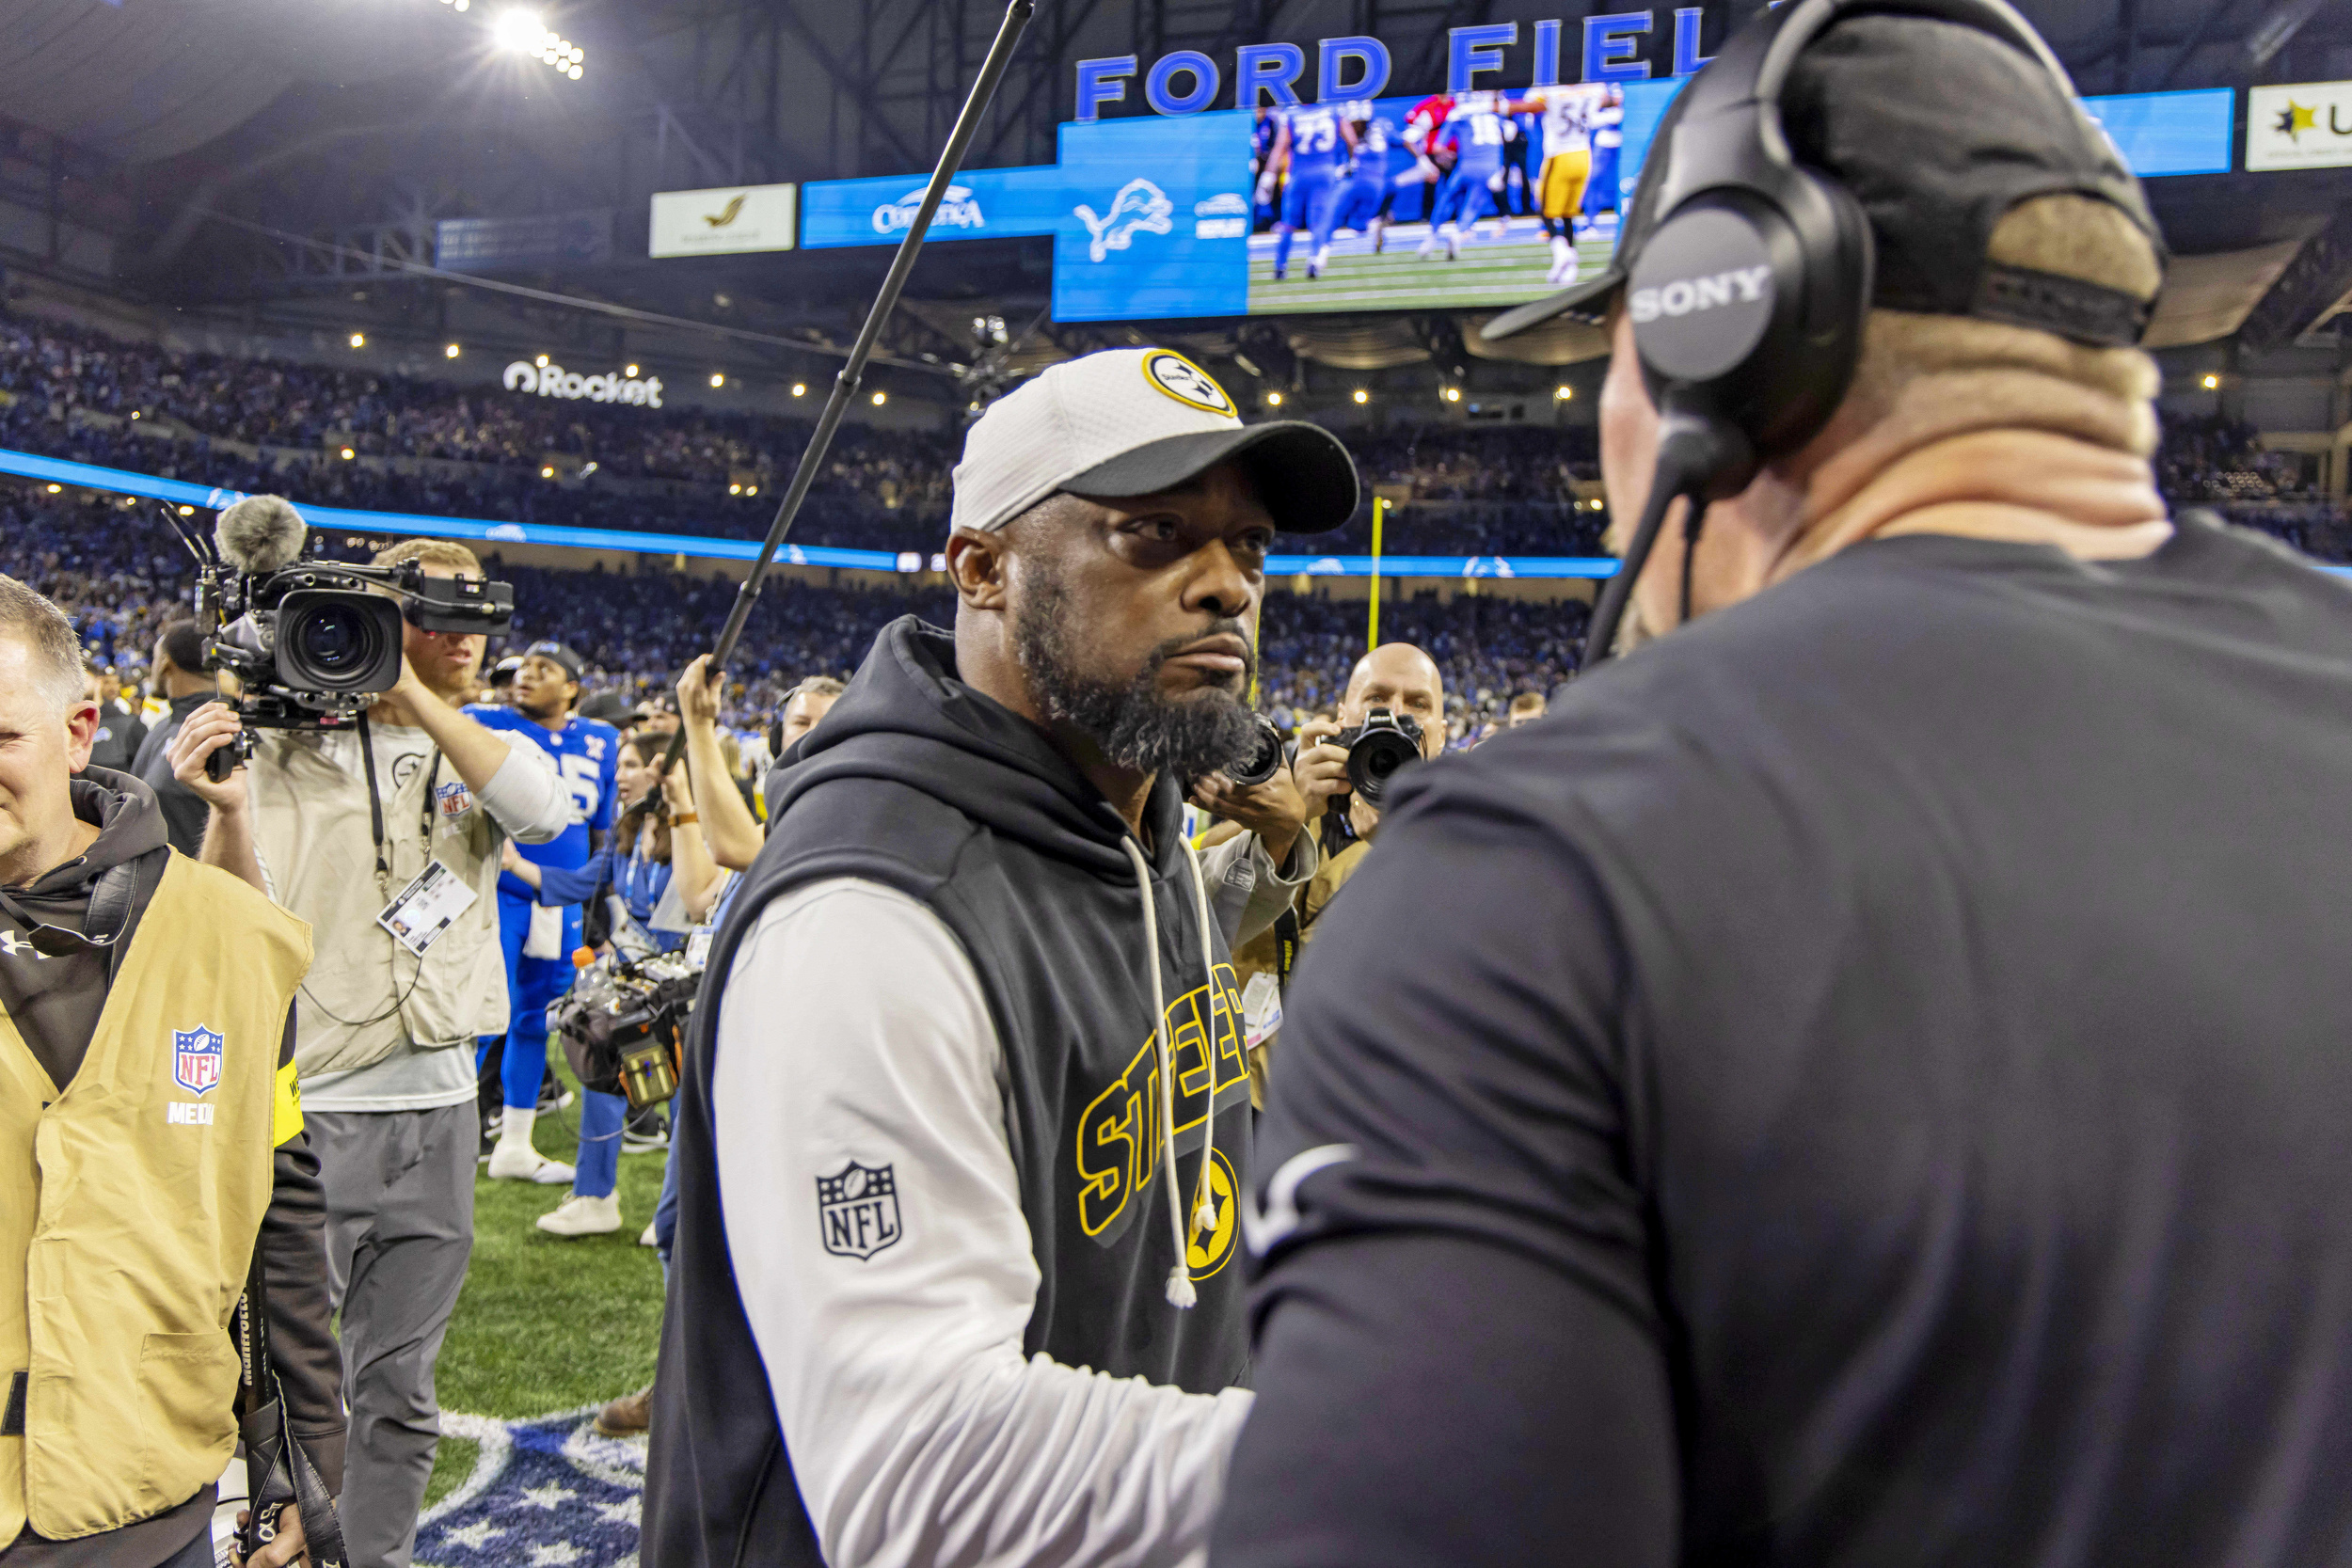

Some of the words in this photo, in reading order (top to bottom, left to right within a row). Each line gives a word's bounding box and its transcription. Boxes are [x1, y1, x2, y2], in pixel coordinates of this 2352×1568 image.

[1074, 35, 1392, 123] FORD
[1447, 0, 1784, 93] FIEL
[1629, 264, 1770, 323] SONY
[537, 364, 663, 409] Rocket
[442, 794, 470, 815] NFL
[548, 752, 601, 825] 5
[180, 1053, 219, 1086] NFL
[827, 1201, 895, 1249] NFL
[239, 1291, 253, 1386] Manfrotto
